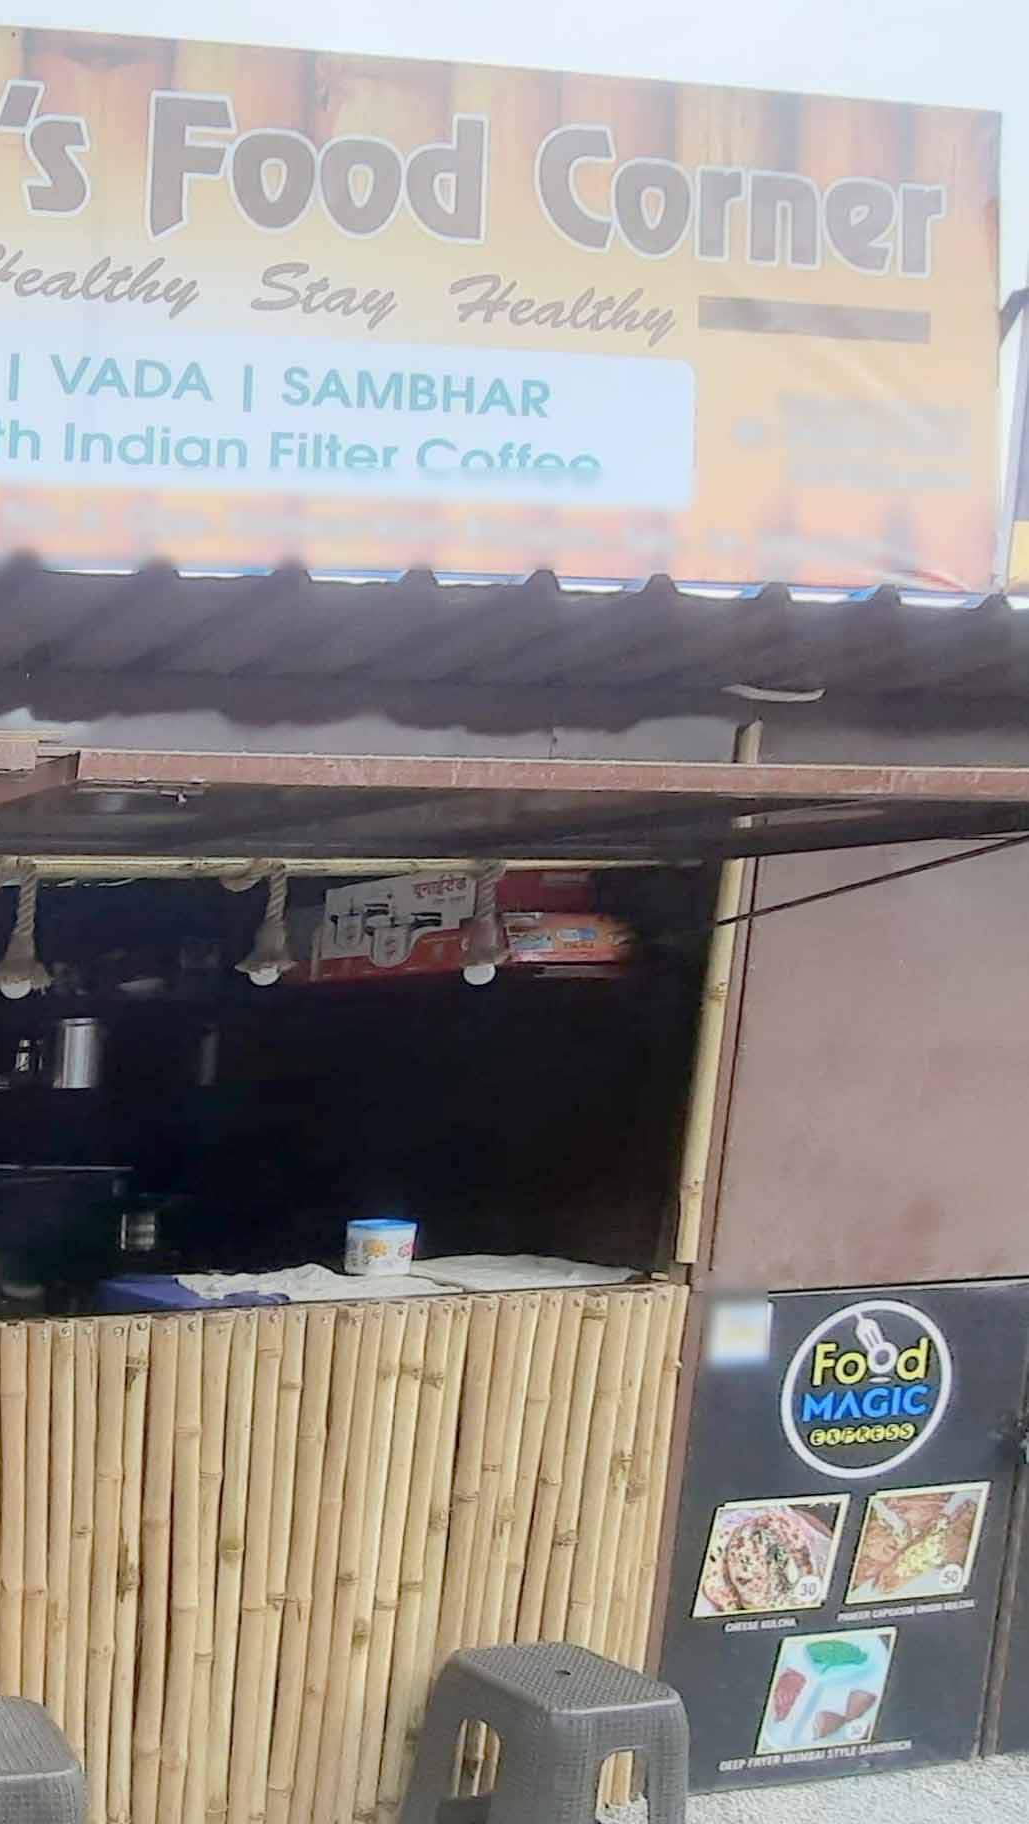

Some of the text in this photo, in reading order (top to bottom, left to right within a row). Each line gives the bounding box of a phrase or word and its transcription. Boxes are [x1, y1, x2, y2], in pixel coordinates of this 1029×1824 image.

[146, 91, 490, 243] Food
[535, 123, 947, 278] Corner
[251, 262, 397, 329] Stay
[449, 274, 676, 346] Healthy
[51, 354, 213, 402] VADA
[281, 367, 551, 418] SAMBHAR
[63, 421, 248, 469] Indian
[270, 432, 399, 471] Filter
[812, 1337, 929, 1386] Food
[802, 1384, 929, 1422] MAGIC
